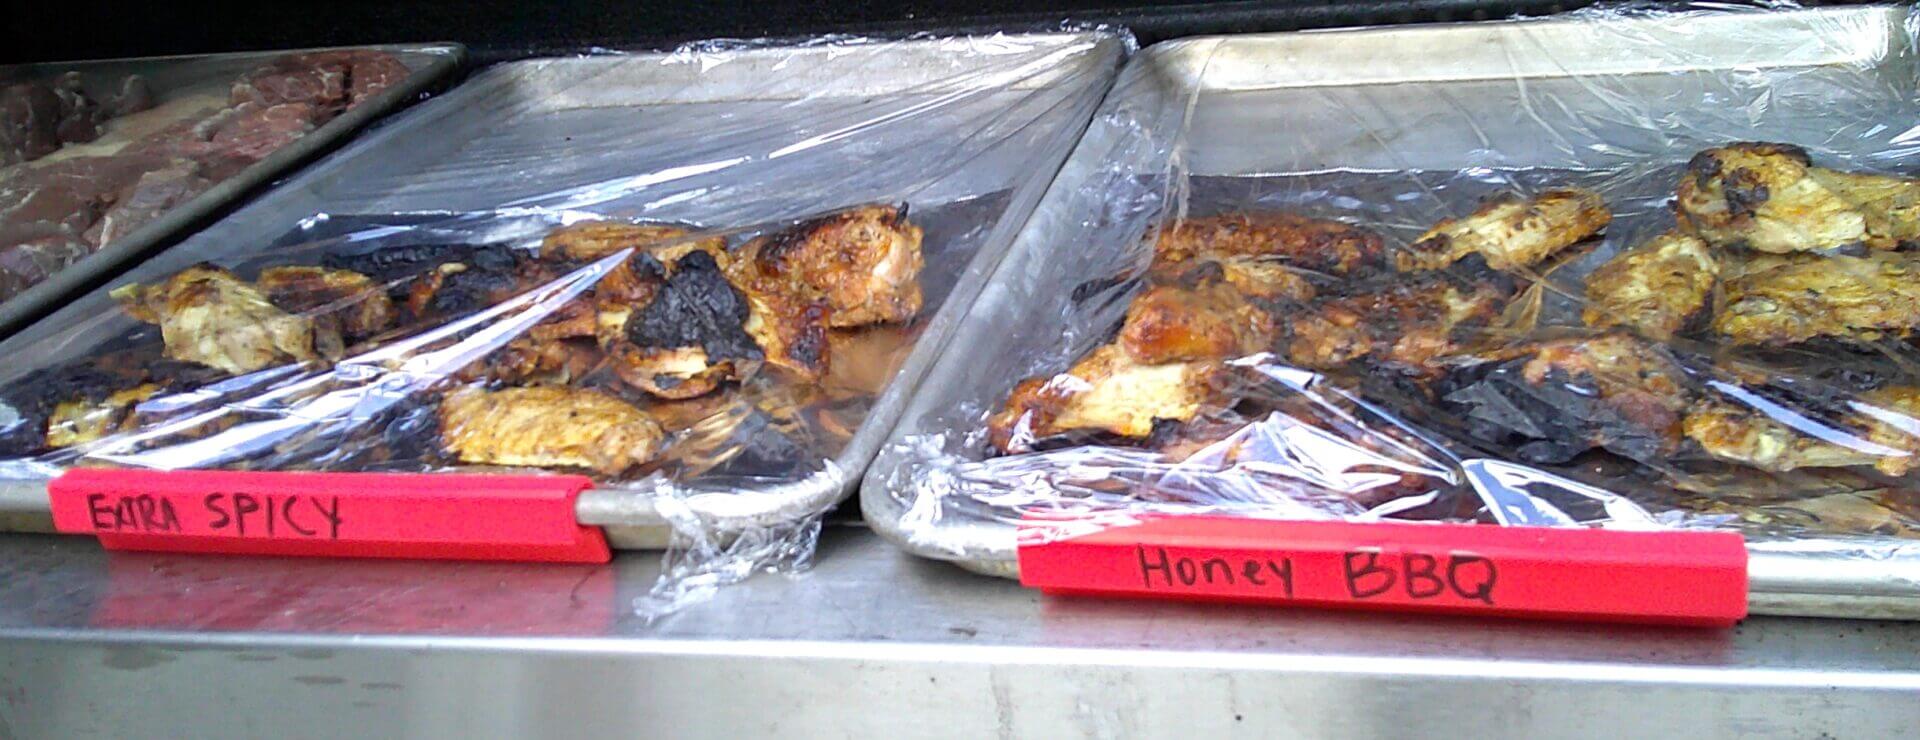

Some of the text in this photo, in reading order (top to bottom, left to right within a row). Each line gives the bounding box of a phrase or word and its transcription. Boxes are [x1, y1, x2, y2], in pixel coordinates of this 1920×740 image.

[203, 492, 342, 539] SPICY
[1137, 543, 1498, 604] Honey BBQ
